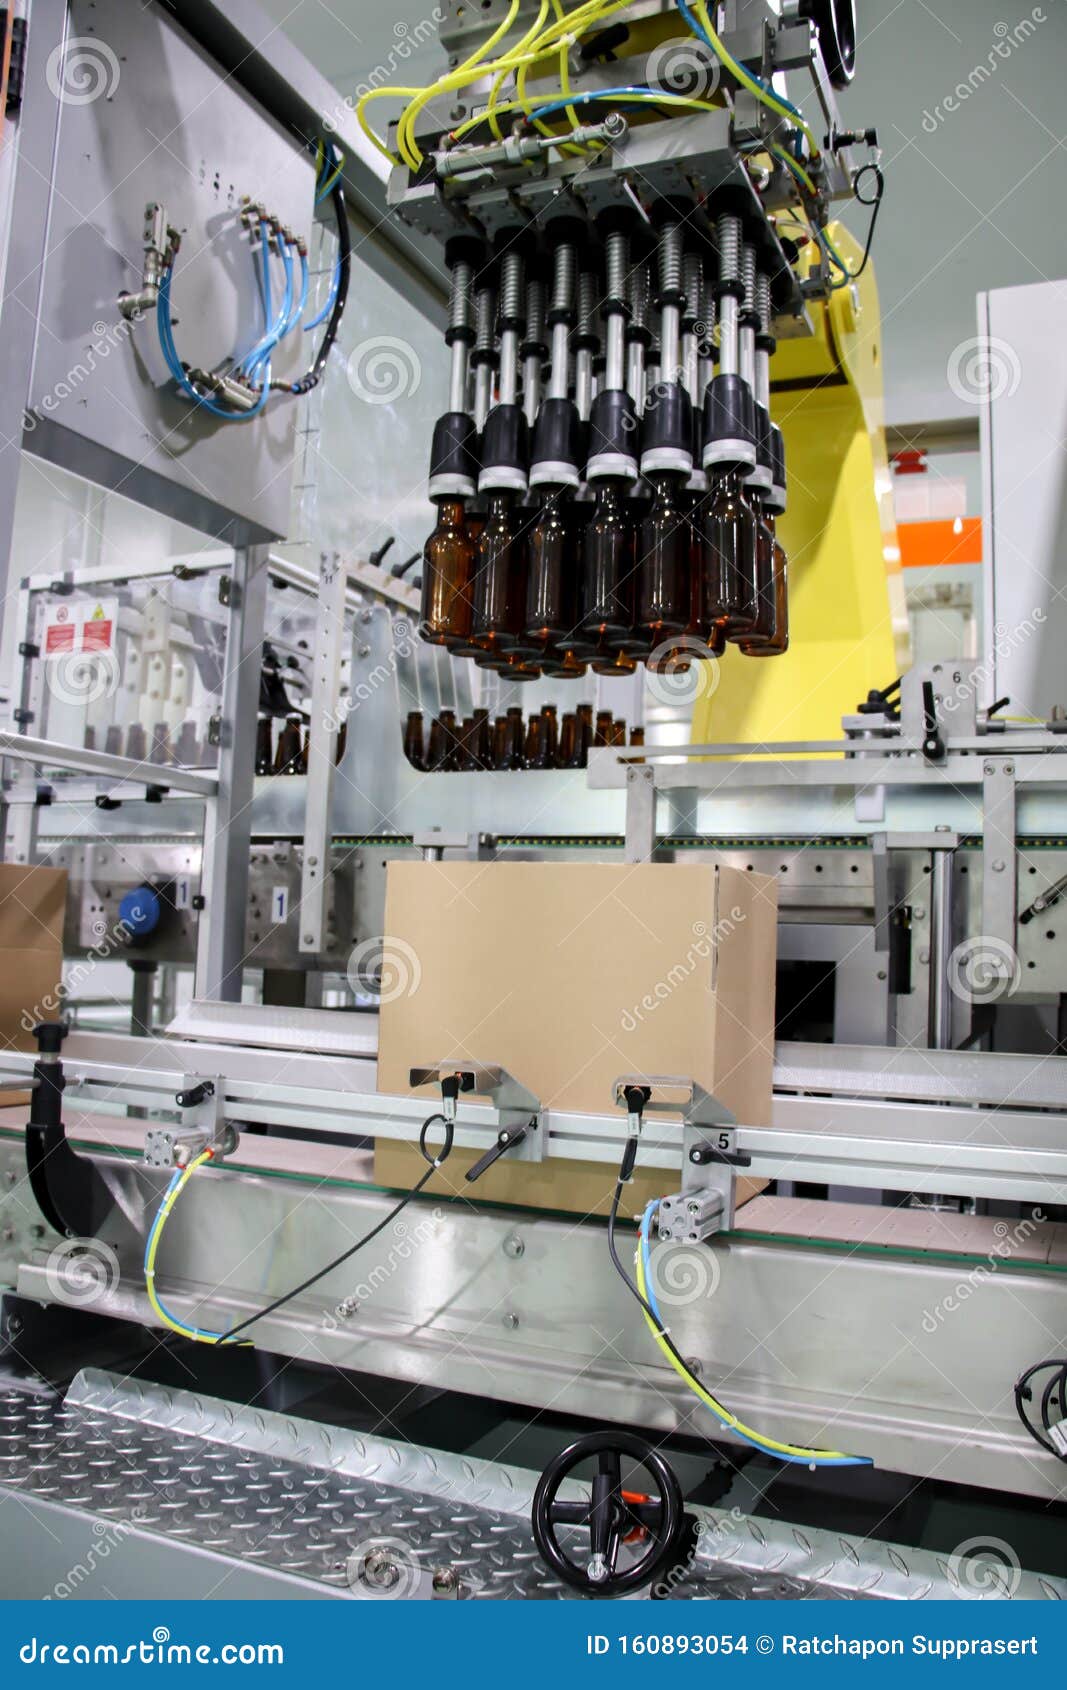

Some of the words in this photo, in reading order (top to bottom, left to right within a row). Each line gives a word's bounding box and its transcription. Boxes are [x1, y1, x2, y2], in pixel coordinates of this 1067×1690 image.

[952, 671, 961, 684] 6
[180, 881, 187, 903] 1
[277, 893, 284, 917] 1
[528, 1114, 538, 1131] 4
[718, 1133, 729, 1150] 5
